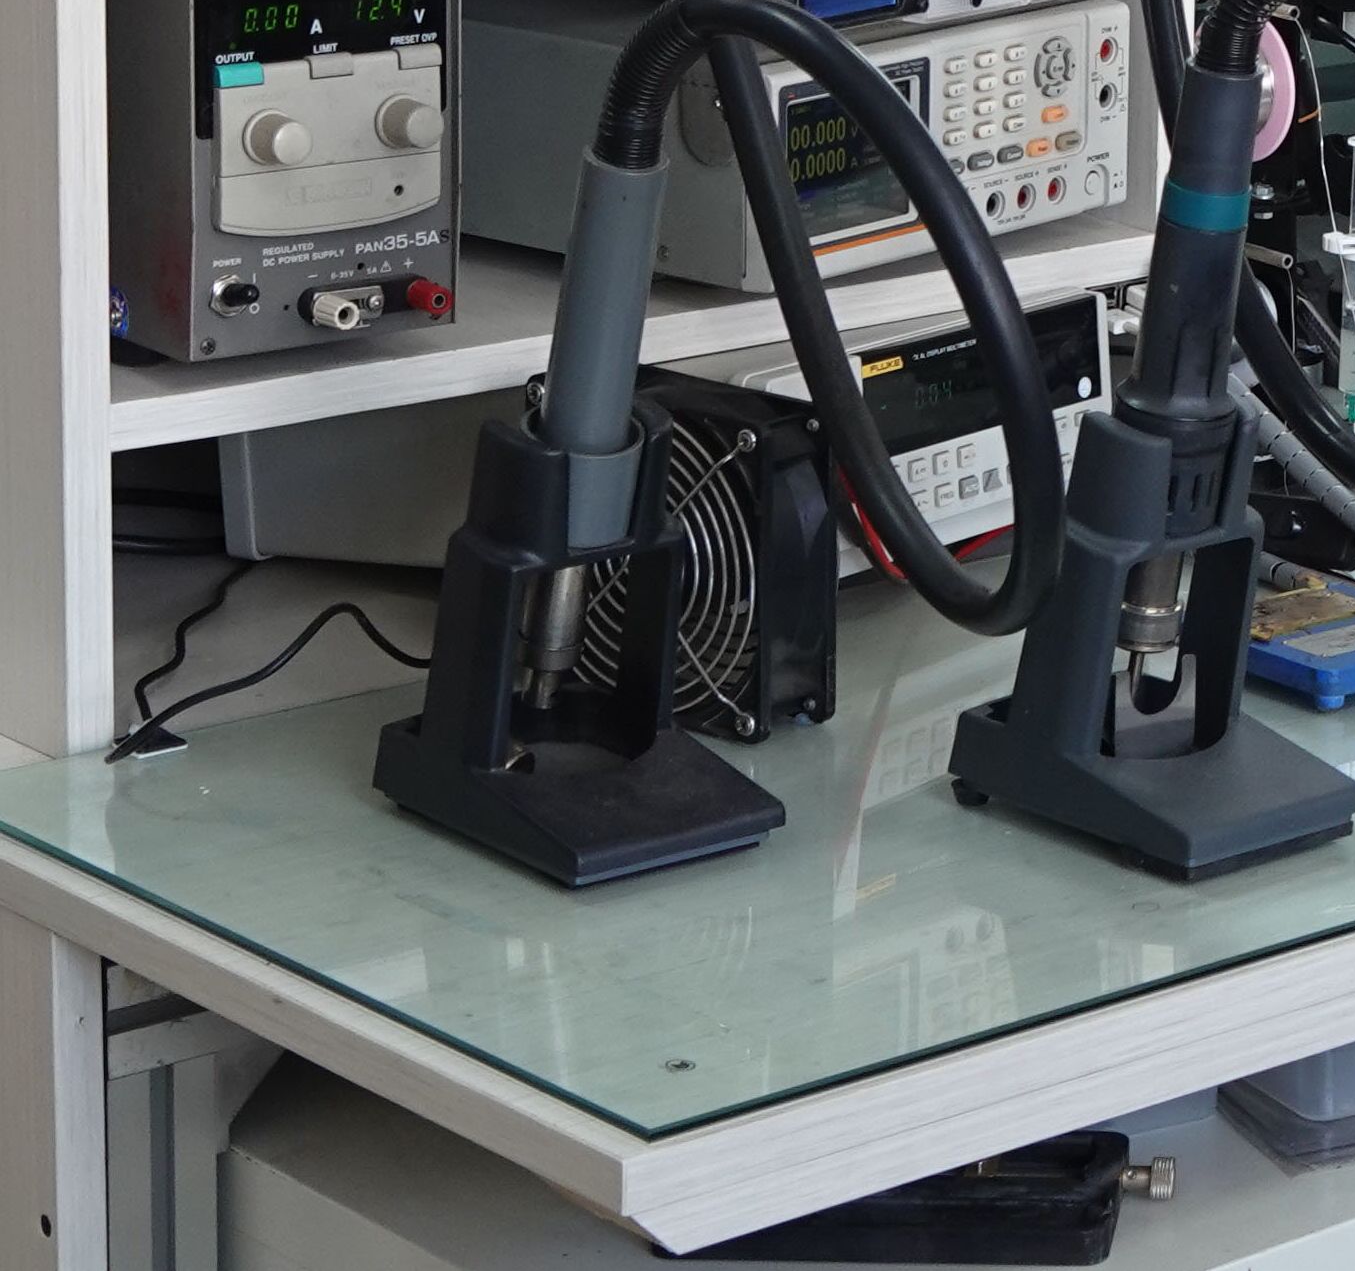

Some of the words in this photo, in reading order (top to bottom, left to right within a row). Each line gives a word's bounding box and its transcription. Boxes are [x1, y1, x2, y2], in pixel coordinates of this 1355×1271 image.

[244, 4, 298, 33] 0.00
[414, 8, 426, 24] V
[310, 18, 323, 35] A
[390, 34, 420, 46] PRESET
[313, 42, 339, 54] LIMIT
[215, 51, 255, 64] OUTPUT
[1087, 152, 1110, 163] POWER
[263, 243, 314, 256] REGULATED
[213, 258, 242, 269] POWER
[263, 258, 276, 267] DC
[278, 253, 310, 265] POWER
[312, 249, 345, 262] SUPPLY
[869, 358, 900, 373] FLUKE
